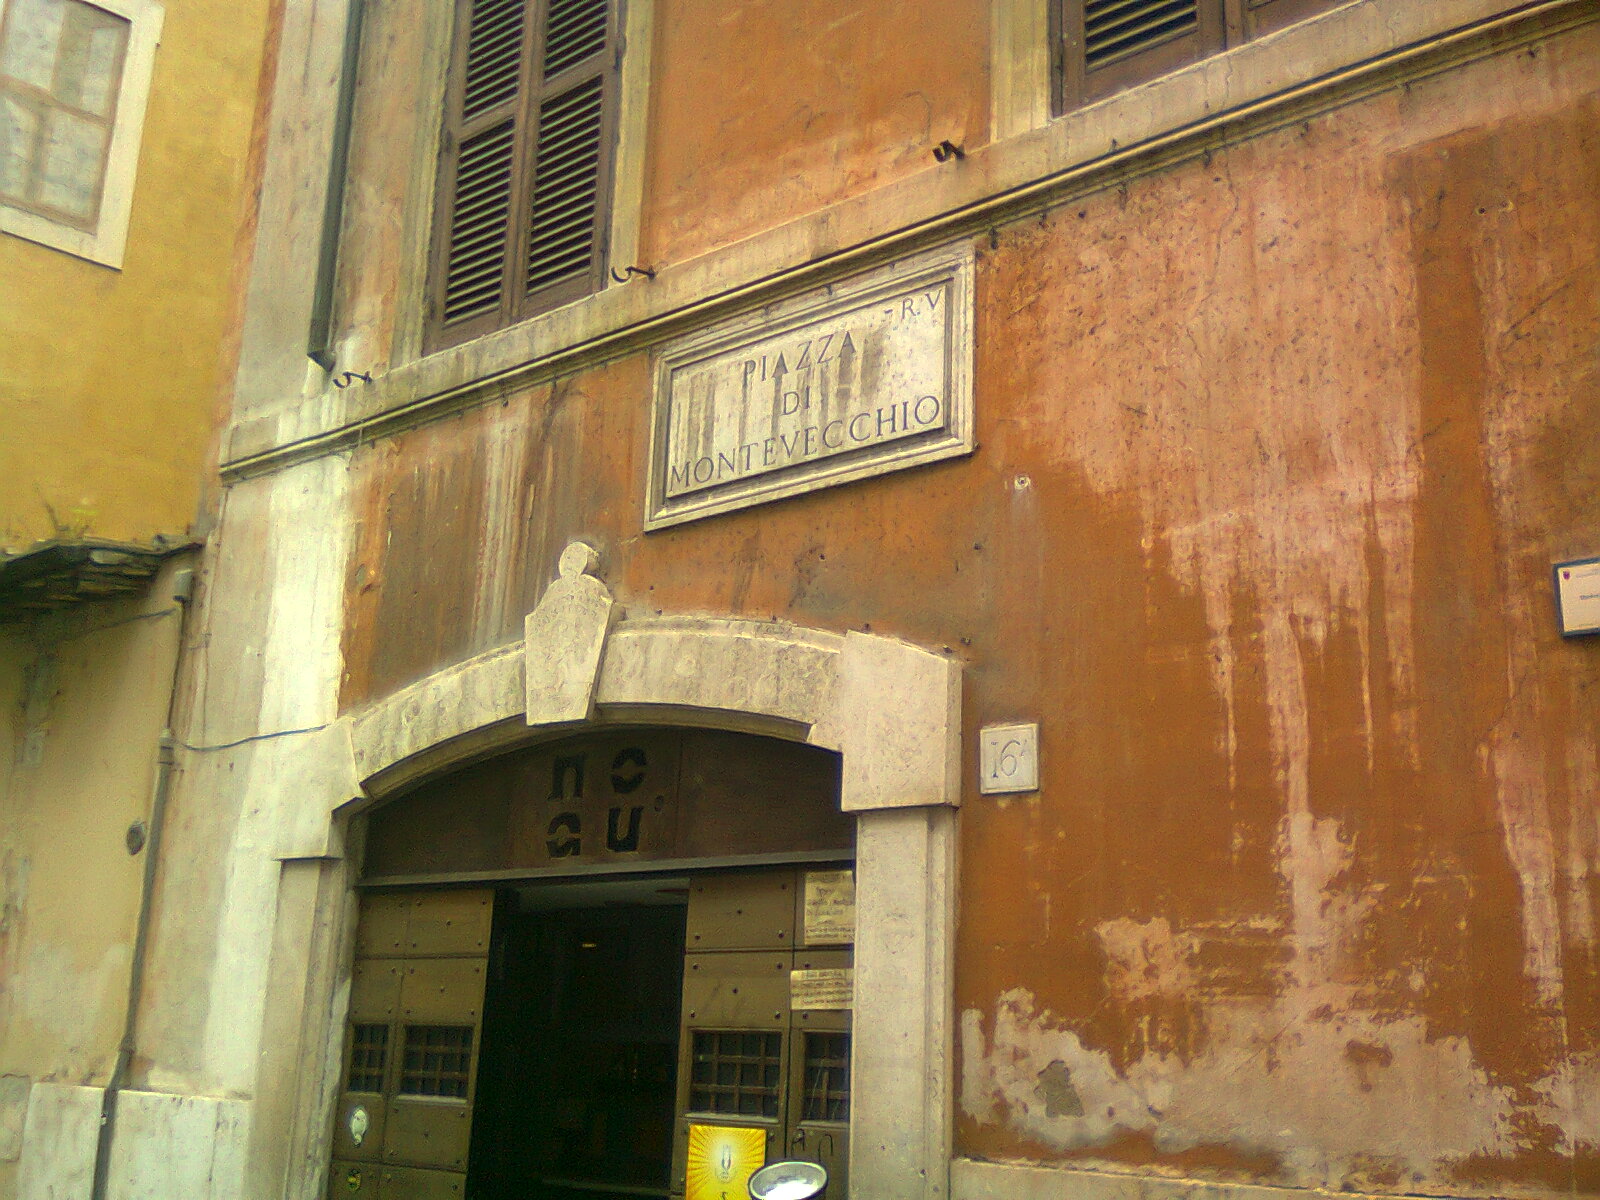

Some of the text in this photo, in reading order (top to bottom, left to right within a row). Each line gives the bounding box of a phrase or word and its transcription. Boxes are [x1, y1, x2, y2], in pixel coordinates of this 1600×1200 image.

[743, 331, 857, 387] PIAZZA
[780, 385, 811, 416] DI
[668, 395, 941, 492] MONTEVECCHIO
